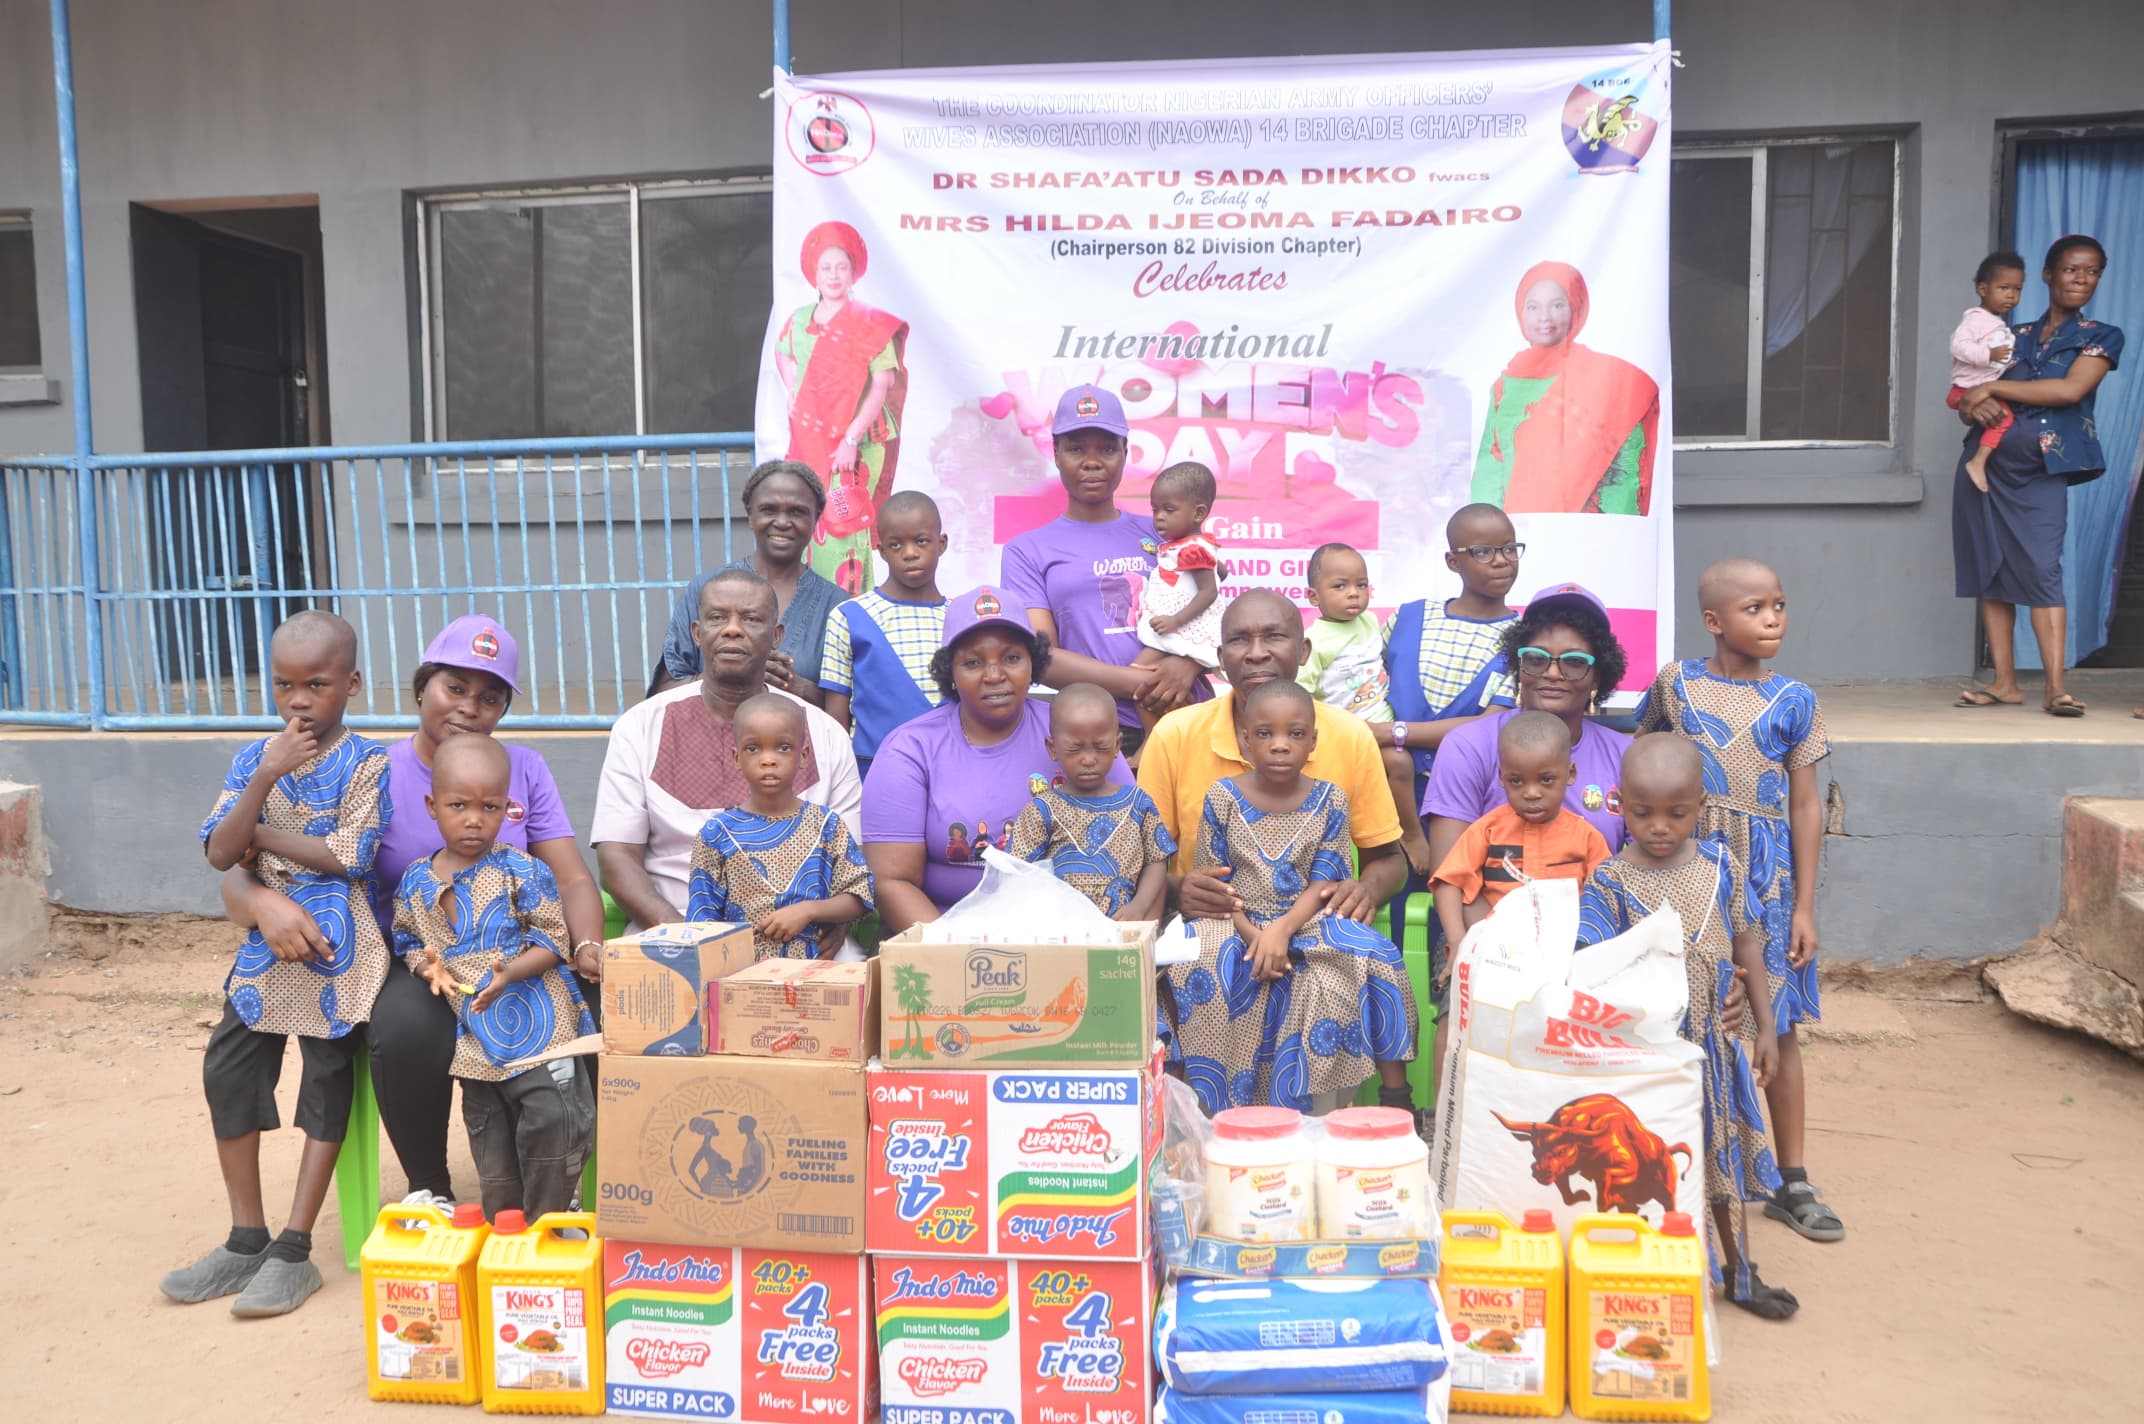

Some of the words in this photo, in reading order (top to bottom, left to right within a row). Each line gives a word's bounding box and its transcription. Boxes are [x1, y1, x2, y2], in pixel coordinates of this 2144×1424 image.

[934, 96, 979, 118] THE
[986, 91, 1155, 117] COORDINATOR
[1163, 86, 1281, 113] NIGERIAN
[1287, 84, 1359, 110] ARMY
[1365, 80, 1494, 108] OFFICERS'
[903, 126, 977, 150] WIVES
[983, 121, 1141, 148] ASSOCIATION
[1148, 119, 1252, 150] (NAOWA)
[1260, 118, 1288, 142] 14
[1295, 116, 1403, 142] BRIGADE
[1411, 114, 1527, 139] CHAPTER
[933, 173, 978, 190] DR
[989, 170, 1180, 188] SHAFA'ATU
[1194, 168, 1288, 186] SADA
[1301, 166, 1416, 185] DIKKO
[1428, 170, 1490, 183] fwacs
[1173, 191, 1194, 206] On
[1200, 190, 1250, 208] Behalf
[1255, 190, 1270, 208] of
[900, 214, 990, 232] MRS
[1005, 213, 1132, 232] HILDA
[1149, 210, 1314, 231] IJEOMA
[1331, 204, 1522, 228] FADAIRO
[1050, 239, 1168, 261] (Chairperson
[1173, 239, 1195, 255] 82
[1202, 237, 1275, 255] Division
[1281, 236, 1362, 258] Chapter)
[1132, 259, 1288, 298] Celebrates
[1052, 323, 1333, 361] International
[1203, 516, 1284, 540] Gain
[1222, 560, 1272, 576] AND
[1116, 955, 1136, 968] 14g
[969, 956, 1021, 988] Peak
[1099, 967, 1138, 979] sachet
[602, 1078, 641, 1091] 6x900g
[1001, 1080, 1060, 1099] PACK
[1066, 1082, 1128, 1100] SUPER
[929, 1087, 969, 1105] More
[1049, 1121, 1090, 1132] Flavor
[1443, 1099, 1456, 1138] Milled
[894, 1122, 944, 1138] Inside
[788, 1138, 847, 1150] FUELING
[890, 1137, 969, 1167] Free
[1026, 1132, 1108, 1153] Chicken
[786, 1149, 848, 1161] FAMILIES
[798, 1161, 837, 1172] WITH
[892, 1162, 938, 1176] packs
[1436, 1139, 1452, 1203] Parboiled
[779, 1171, 855, 1184] GOODNESS
[1029, 1176, 1070, 1189] Noodles
[1072, 1178, 1107, 1189] Instant
[601, 1182, 653, 1206] 900g
[898, 1175, 942, 1218] 4
[936, 1207, 972, 1219] packs
[917, 1217, 976, 1242] 40+
[610, 1250, 722, 1284] Indomie
[753, 1261, 811, 1284] 40+
[386, 1282, 430, 1301] KING'S
[756, 1283, 792, 1295] packs
[881, 1266, 998, 1306] Indomie
[1031, 1272, 1091, 1295] 40+
[505, 1290, 555, 1310] KING'S
[784, 1284, 826, 1327] 4
[1034, 1294, 1072, 1306] packs
[1459, 1288, 1513, 1309] KING'S
[1604, 1294, 1660, 1316] KING'S
[632, 1304, 664, 1317] Instant
[666, 1307, 704, 1321] Noodles
[1065, 1294, 1109, 1338] 4
[787, 1326, 833, 1339] packs
[903, 1322, 937, 1335] Instant
[939, 1324, 980, 1336] Noodles
[628, 1339, 705, 1363] Chicken
[760, 1332, 833, 1363] Free
[1070, 1337, 1116, 1350] packs
[644, 1359, 682, 1373] Flavor
[784, 1361, 831, 1377] Inside
[901, 1358, 981, 1380] Chicken
[1040, 1345, 1119, 1374] Free
[919, 1379, 957, 1390] Flavor
[1066, 1374, 1114, 1388] Inside
[612, 1387, 670, 1410] SUPER
[673, 1391, 727, 1414] PACK
[759, 1392, 797, 1410] More
[885, 1408, 943, 1424] SUPER
[949, 1411, 1006, 1424] PACK
[1039, 1407, 1080, 1424] More
